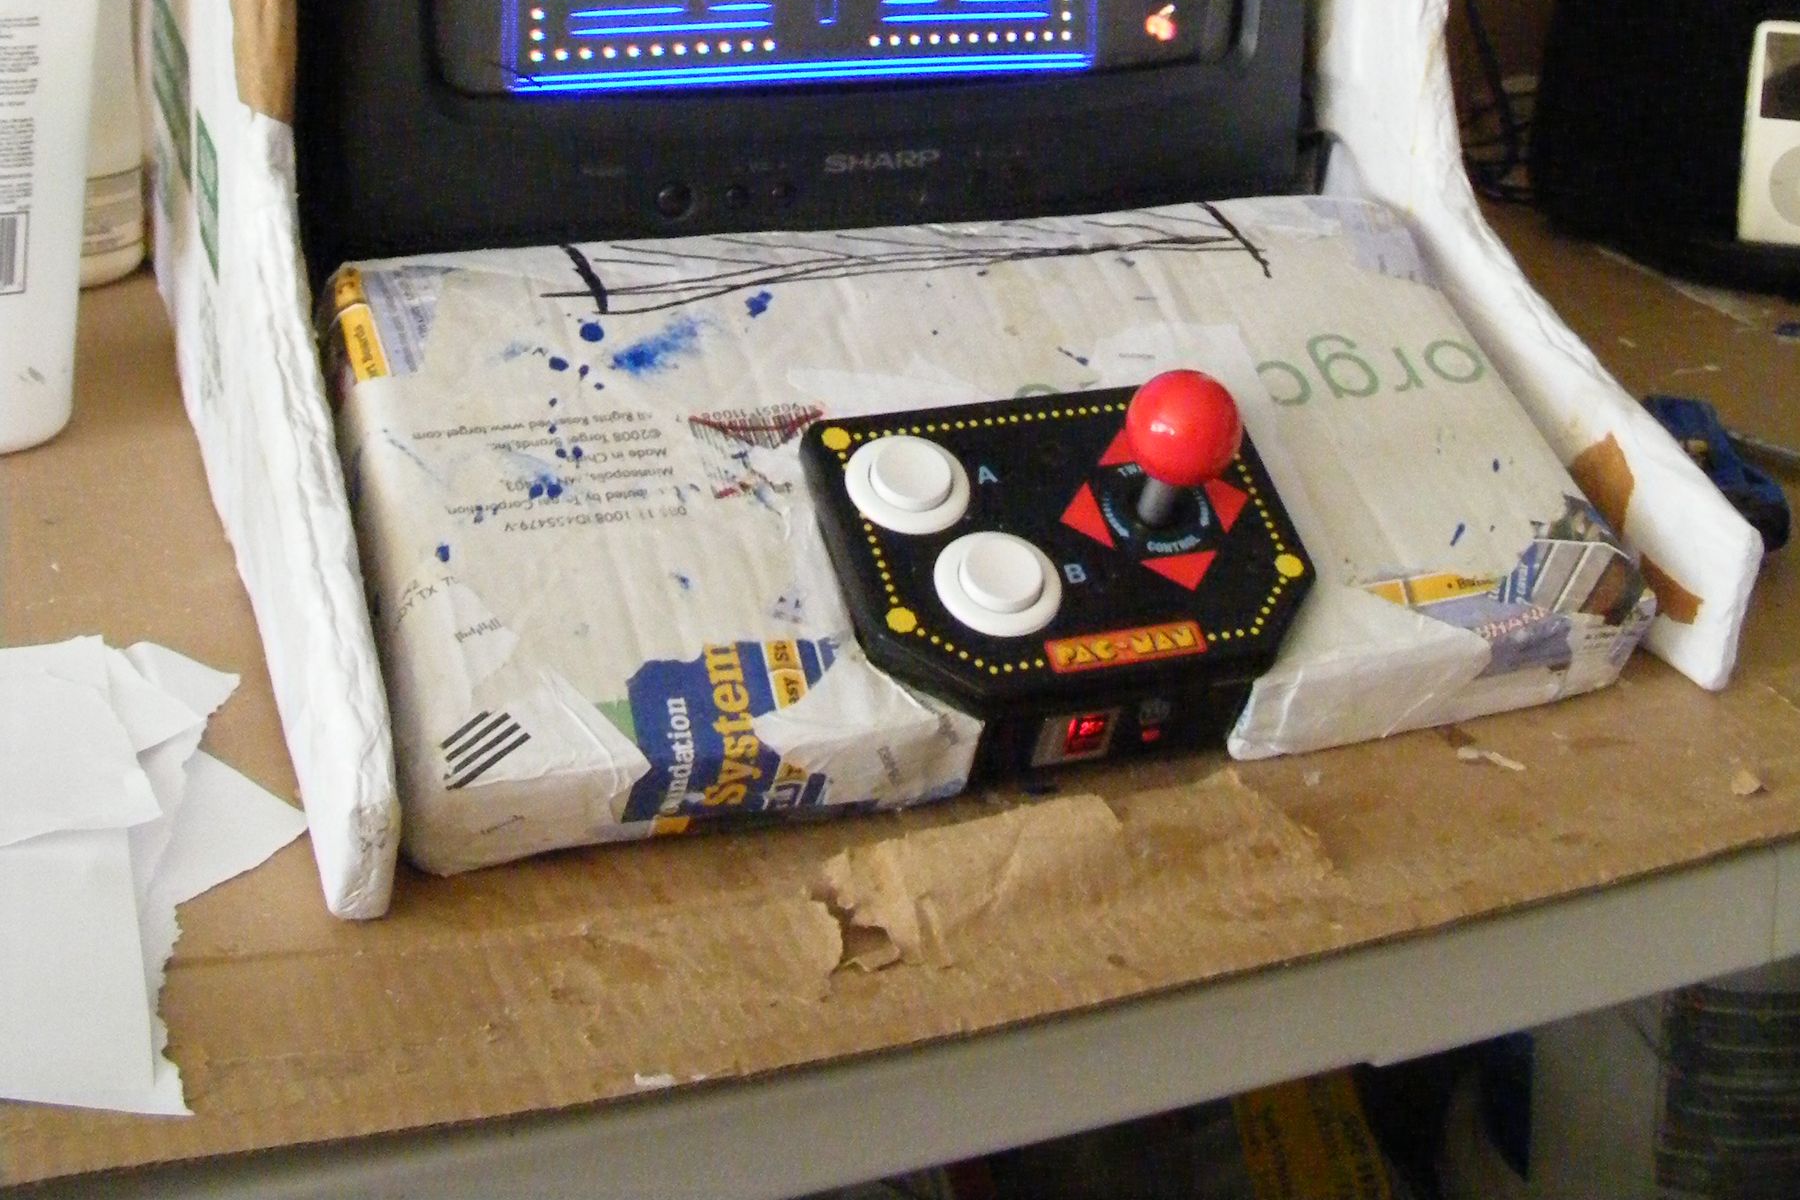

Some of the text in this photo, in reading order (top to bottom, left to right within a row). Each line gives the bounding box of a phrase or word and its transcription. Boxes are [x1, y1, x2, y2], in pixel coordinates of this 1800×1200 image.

[824, 150, 940, 174] SHARP
[592, 411, 635, 424] Rights
[611, 450, 625, 460] in
[628, 447, 668, 461] Made
[978, 465, 998, 485] A
[1063, 563, 1087, 584] B
[1053, 626, 1199, 668] PAC-MAN
[703, 640, 763, 807] System
